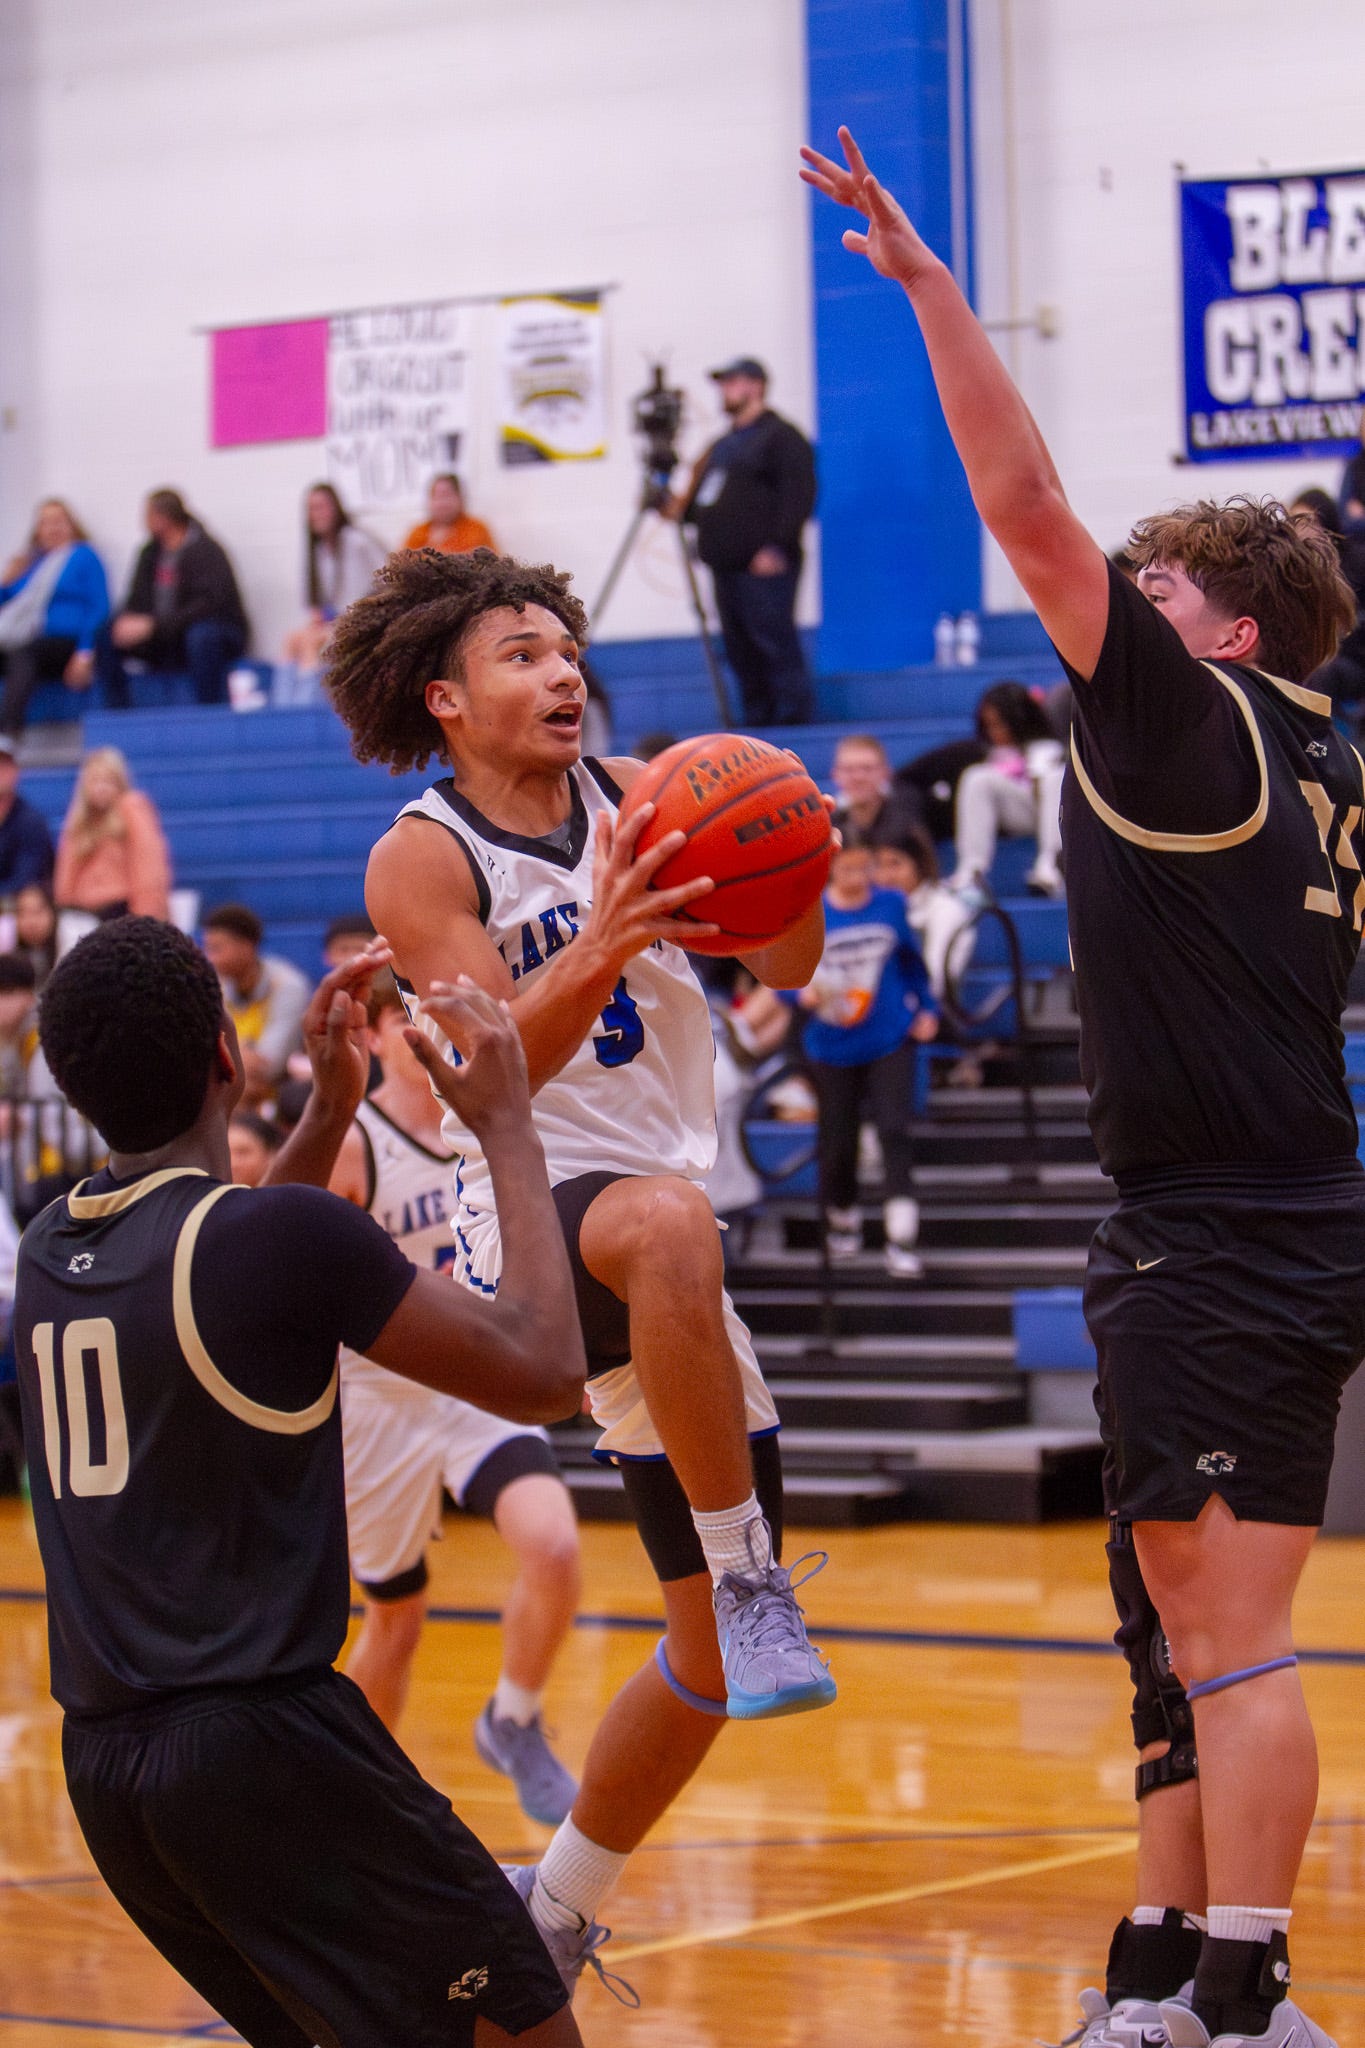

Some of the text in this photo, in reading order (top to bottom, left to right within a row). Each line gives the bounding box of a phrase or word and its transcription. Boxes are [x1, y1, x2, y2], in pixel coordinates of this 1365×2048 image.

[1204, 286, 1365, 408] CRE
[1191, 402, 1362, 448] LAKEVIEW
[32, 1317, 130, 1500] 10
